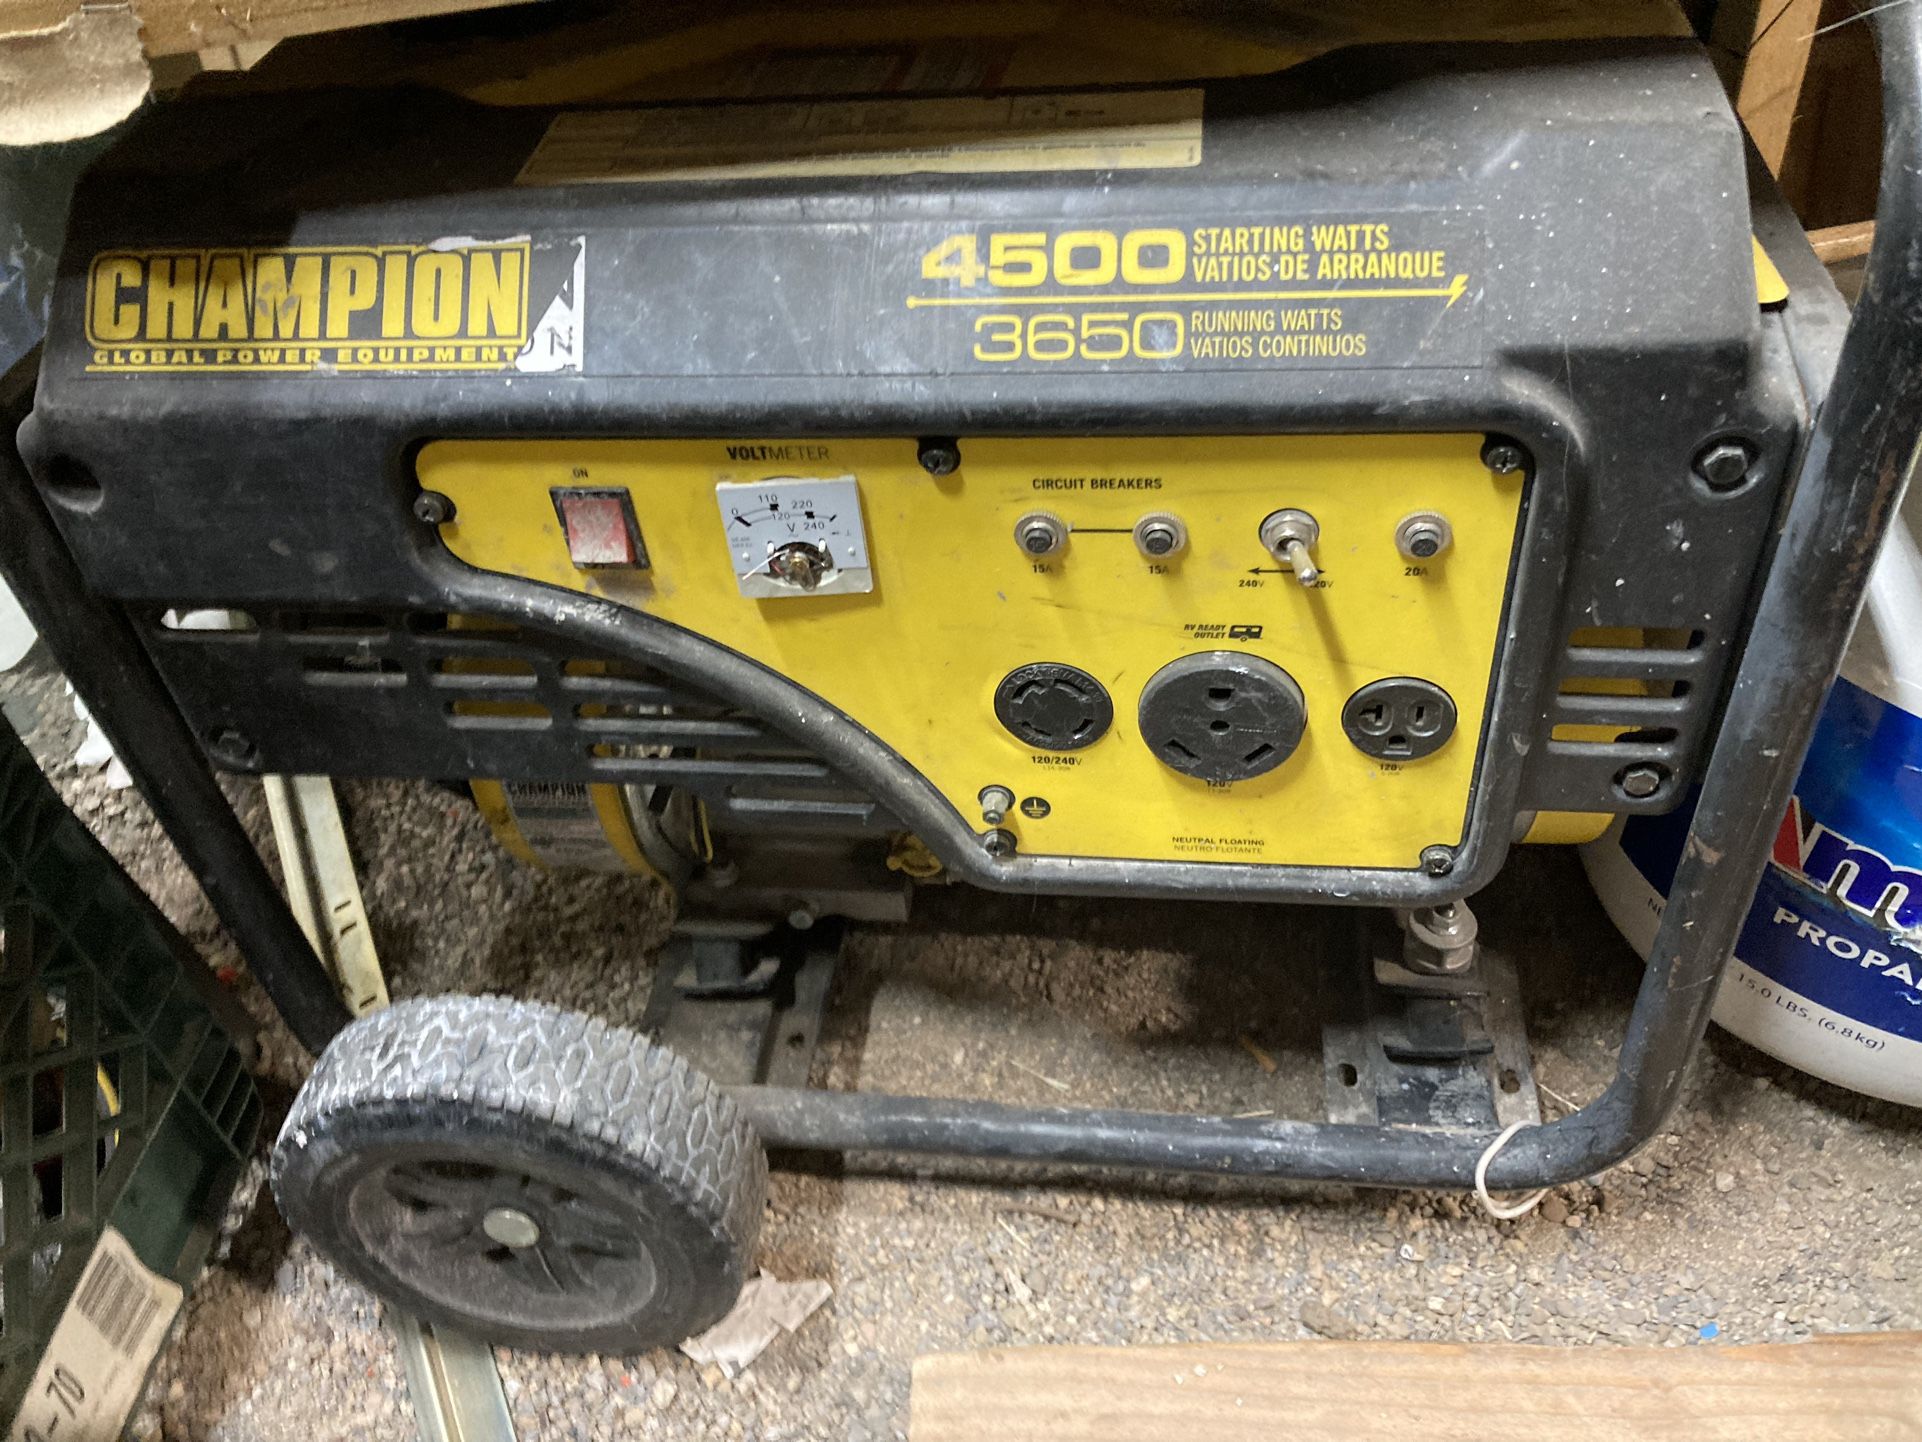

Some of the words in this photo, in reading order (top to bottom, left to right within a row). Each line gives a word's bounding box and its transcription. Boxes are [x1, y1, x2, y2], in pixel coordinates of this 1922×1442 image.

[1193, 225, 1304, 254] STARTING
[1312, 223, 1390, 251] WATTS
[922, 228, 1187, 288] 4500
[1192, 254, 1272, 282] VATIOS
[1279, 254, 1310, 281] DE
[1316, 250, 1446, 280] ARRANQUE
[93, 251, 522, 340] CHAMPION
[1191, 309, 1275, 332] RUNNING
[1281, 308, 1343, 331] WATTS
[973, 311, 1185, 361] 3650
[1190, 335, 1252, 358] VATIOS
[1258, 333, 1367, 357] CONTINUOS
[94, 349, 205, 366] GLOBAL
[216, 348, 322, 365] POWER
[337, 346, 517, 364] EQUIPMENT
[726, 445, 830, 461] VOLTMETER
[572, 467, 589, 478] ON
[1032, 477, 1086, 490] CIRCUIT
[1090, 477, 1163, 490] BREAKERS
[758, 493, 778, 503] 110
[791, 500, 813, 510] 220
[771, 511, 791, 521] 120
[803, 522, 825, 531] 240
[1032, 563, 1053, 574] 15A
[1148, 565, 1170, 575] 15A
[1404, 566, 1428, 577] 20A
[1238, 579, 1265, 589] 240V
[1307, 579, 1335, 589] 20V
[1198, 623, 1227, 632] READY
[1194, 631, 1226, 640] OUTLET
[1031, 755, 1083, 766] 120/240V
[1219, 836, 1265, 847] FLOATING
[1173, 844, 1214, 854] NEUTRO
[1216, 845, 1264, 855] FLOTANTE
[1737, 972, 1772, 1000] 15.0
